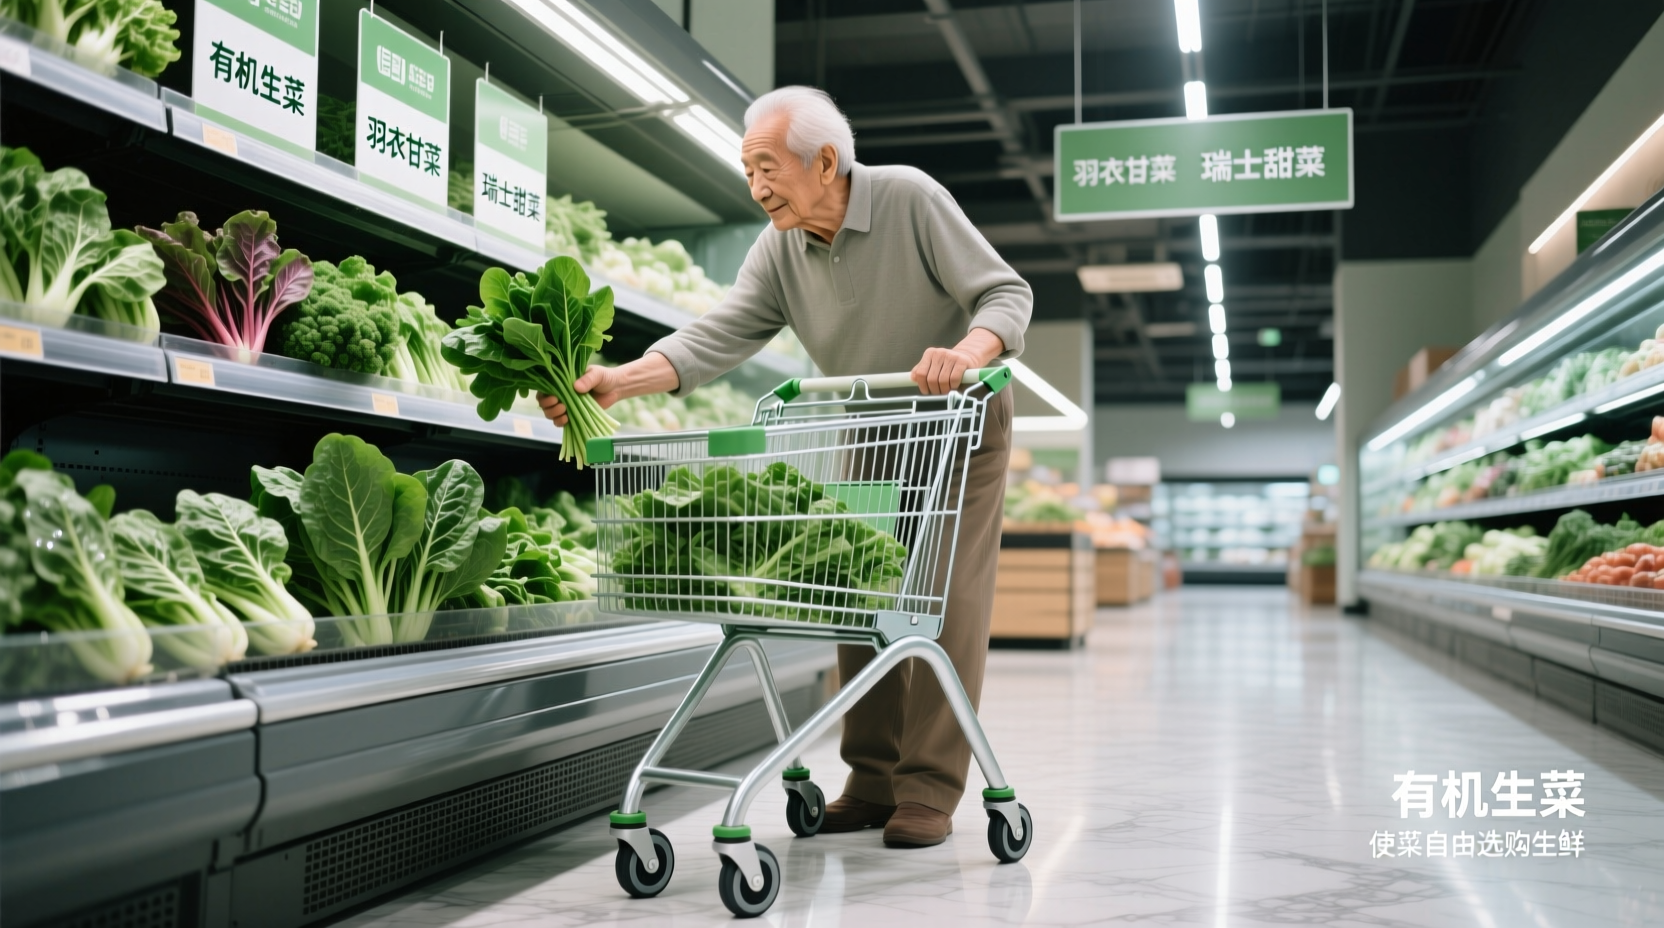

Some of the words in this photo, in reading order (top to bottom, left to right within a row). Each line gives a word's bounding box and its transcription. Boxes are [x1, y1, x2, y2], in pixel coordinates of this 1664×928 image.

[209, 40, 306, 116] 有机生菜
[366, 116, 442, 177] 羽衣甘菜
[1073, 155, 1177, 187] 羽衣甘菜
[1200, 145, 1326, 182] 瑞士甜菜
